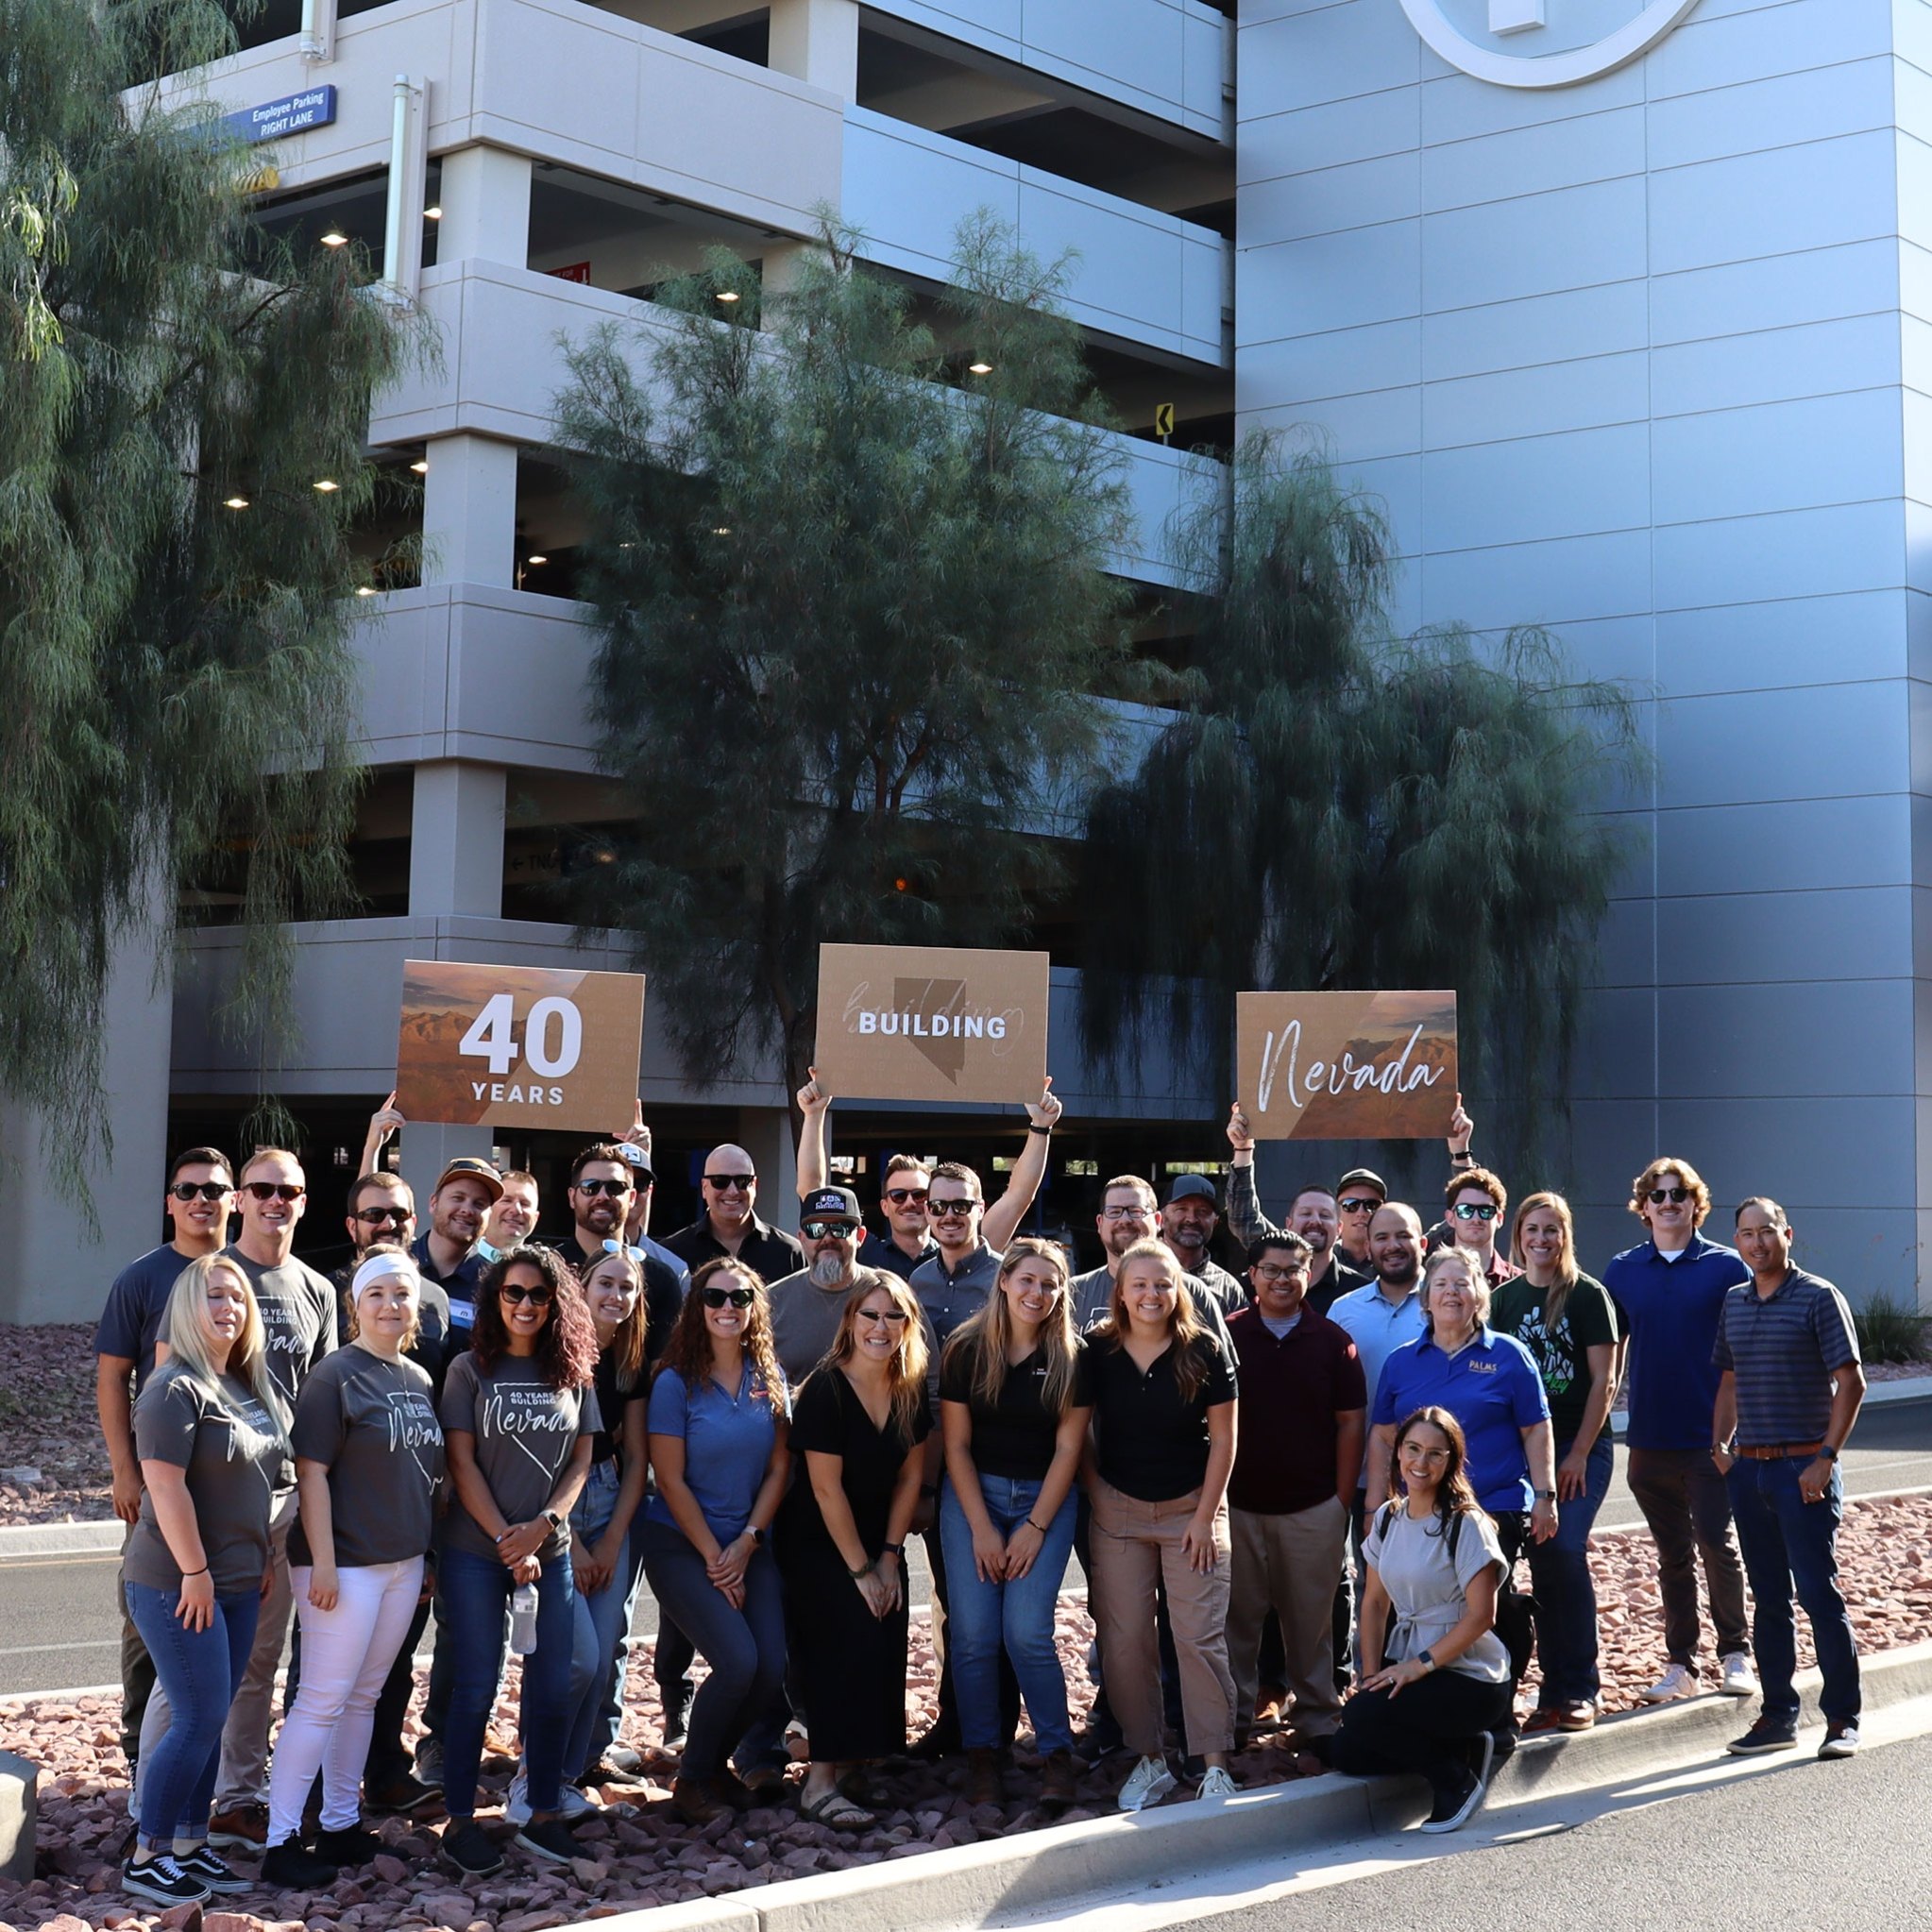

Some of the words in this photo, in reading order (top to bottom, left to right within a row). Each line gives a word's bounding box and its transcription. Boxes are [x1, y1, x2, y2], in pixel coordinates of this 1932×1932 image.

[252, 103, 291, 122] Employee
[293, 93, 324, 110] Parking
[261, 119, 287, 136] RIGHT
[290, 110, 314, 127] LANE
[459, 993, 583, 1078] 40
[858, 1011, 1007, 1039] BUILDING
[1258, 1019, 1446, 1112] Nevada
[471, 1081, 565, 1106] YEARS
[263, 1315, 297, 1325] UILDING
[1468, 1359, 1498, 1371] PALMS
[511, 1398, 557, 1406] BUILDING
